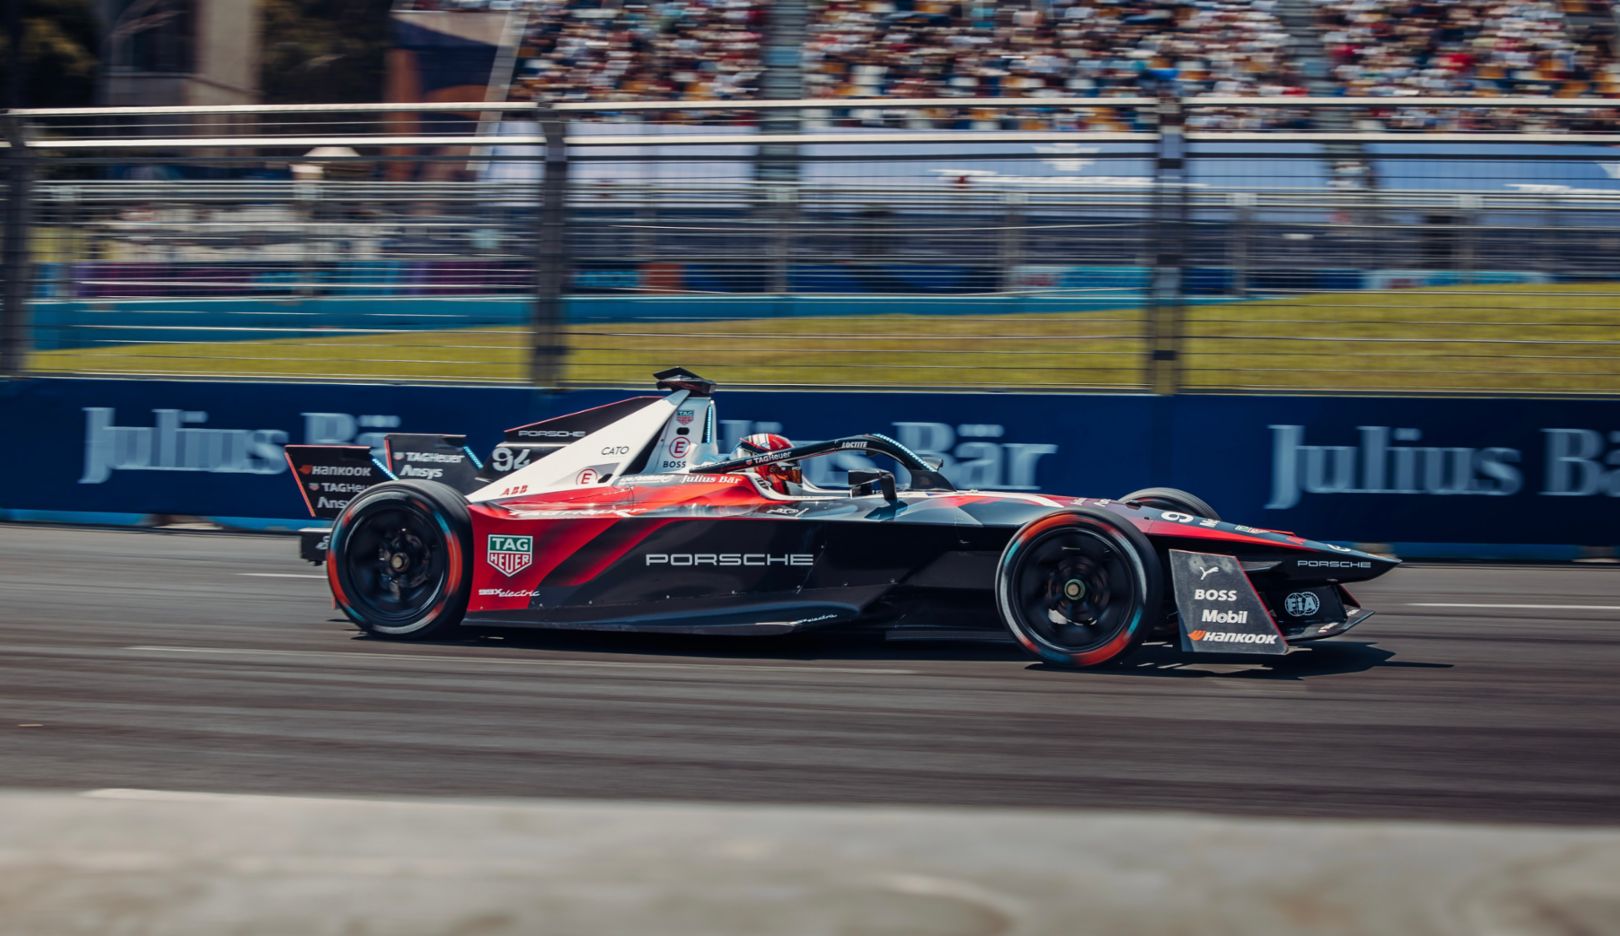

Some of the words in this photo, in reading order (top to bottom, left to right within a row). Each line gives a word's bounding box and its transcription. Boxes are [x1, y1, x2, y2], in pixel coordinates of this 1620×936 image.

[82, 406, 288, 484] Julius
[600, 446, 630, 455] CATO
[841, 441, 868, 449] LOCTITE
[492, 447, 531, 472] 94
[400, 464, 443, 479] Ansys
[1266, 424, 1523, 509] Julius
[681, 474, 716, 483] Julius
[321, 482, 370, 493] TAGHe
[501, 485, 528, 496] ABB
[317, 496, 350, 509] Ans
[492, 538, 529, 551] TAG
[490, 553, 530, 573] HEUER
[645, 553, 814, 566] PORSCHE
[1297, 560, 1372, 568] PORSCHE
[1194, 589, 1237, 601] BOSS
[1288, 597, 1316, 612] FIA
[1201, 609, 1248, 624] Mobil
